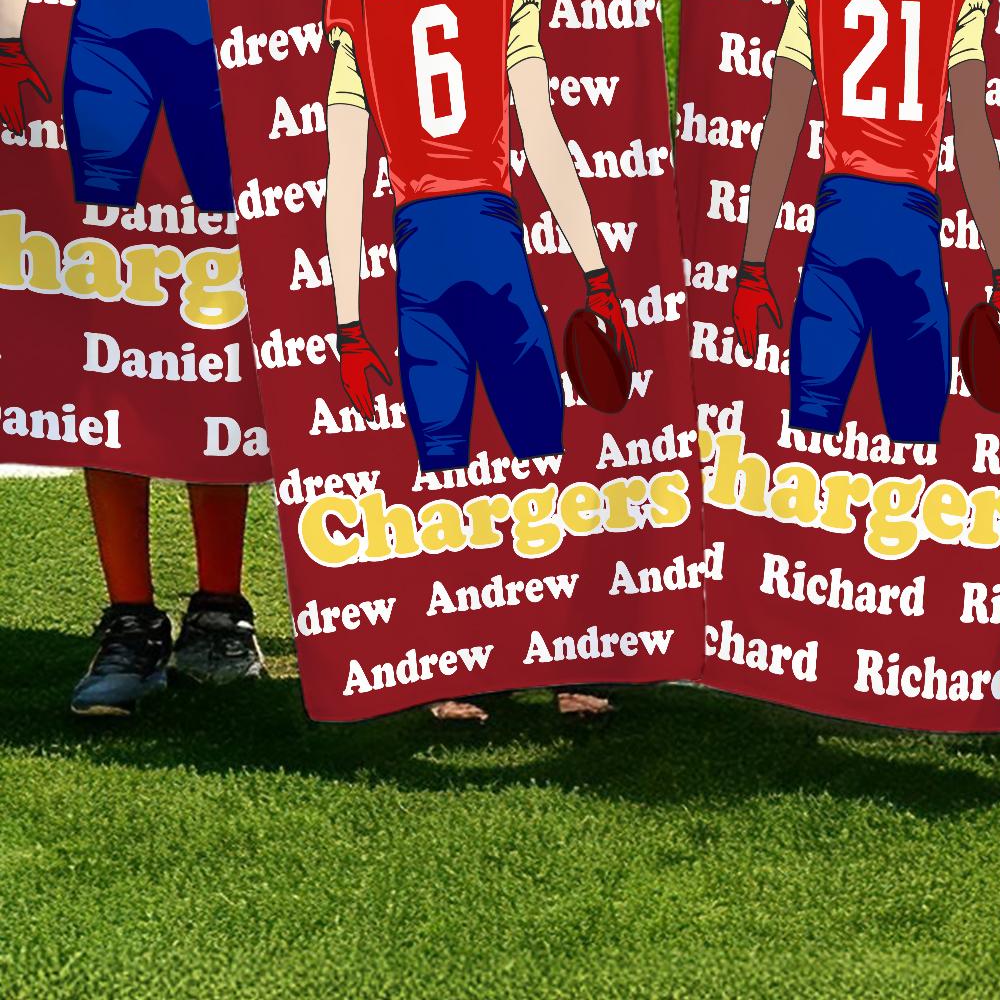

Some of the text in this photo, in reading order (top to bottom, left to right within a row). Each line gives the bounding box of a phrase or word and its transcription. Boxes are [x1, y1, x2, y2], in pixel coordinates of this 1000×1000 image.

[214, 21, 322, 70] drew
[412, 4, 466, 138] 6
[236, 179, 326, 221] drew
[569, 140, 674, 178] Andr
[83, 332, 241, 382] Daniel
[2, 404, 121, 448] aniel
[412, 451, 562, 492] Andrew
[299, 470, 691, 567] Chargers
[292, 597, 396, 638] drew
[426, 574, 579, 616] Andrew
[760, 553, 925, 616] Richard
[343, 626, 674, 695] Andrew Andrew
